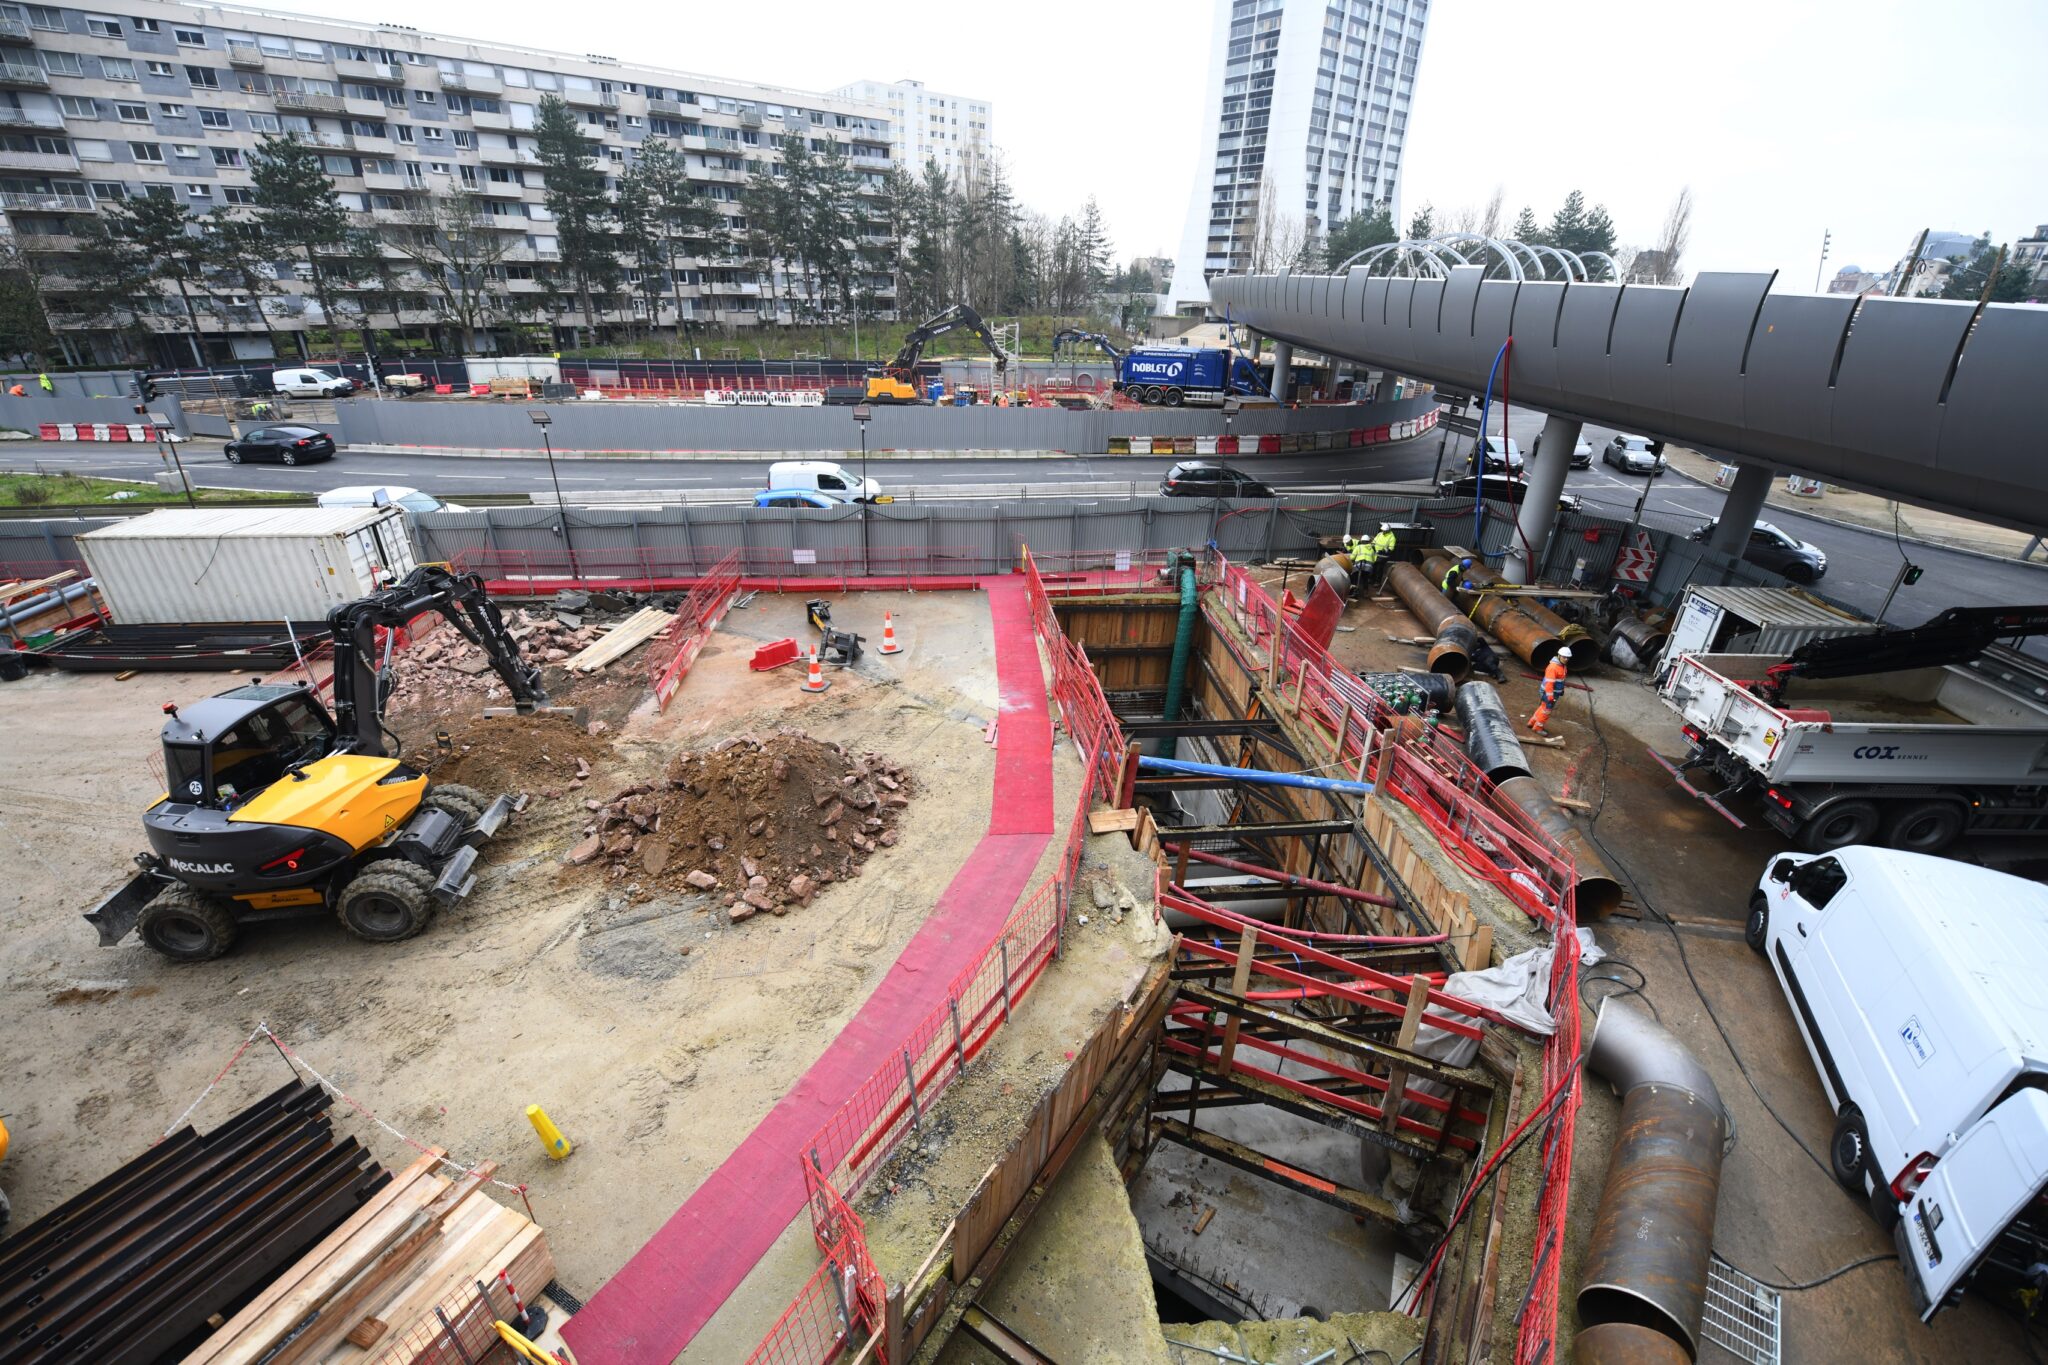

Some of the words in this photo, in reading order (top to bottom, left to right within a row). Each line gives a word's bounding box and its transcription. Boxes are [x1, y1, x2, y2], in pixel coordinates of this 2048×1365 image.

[933, 325, 952, 335] VOLVO
[1132, 362, 1168, 374] NOBLET
[1853, 746, 1900, 760] COX
[191, 782, 201, 794] 25
